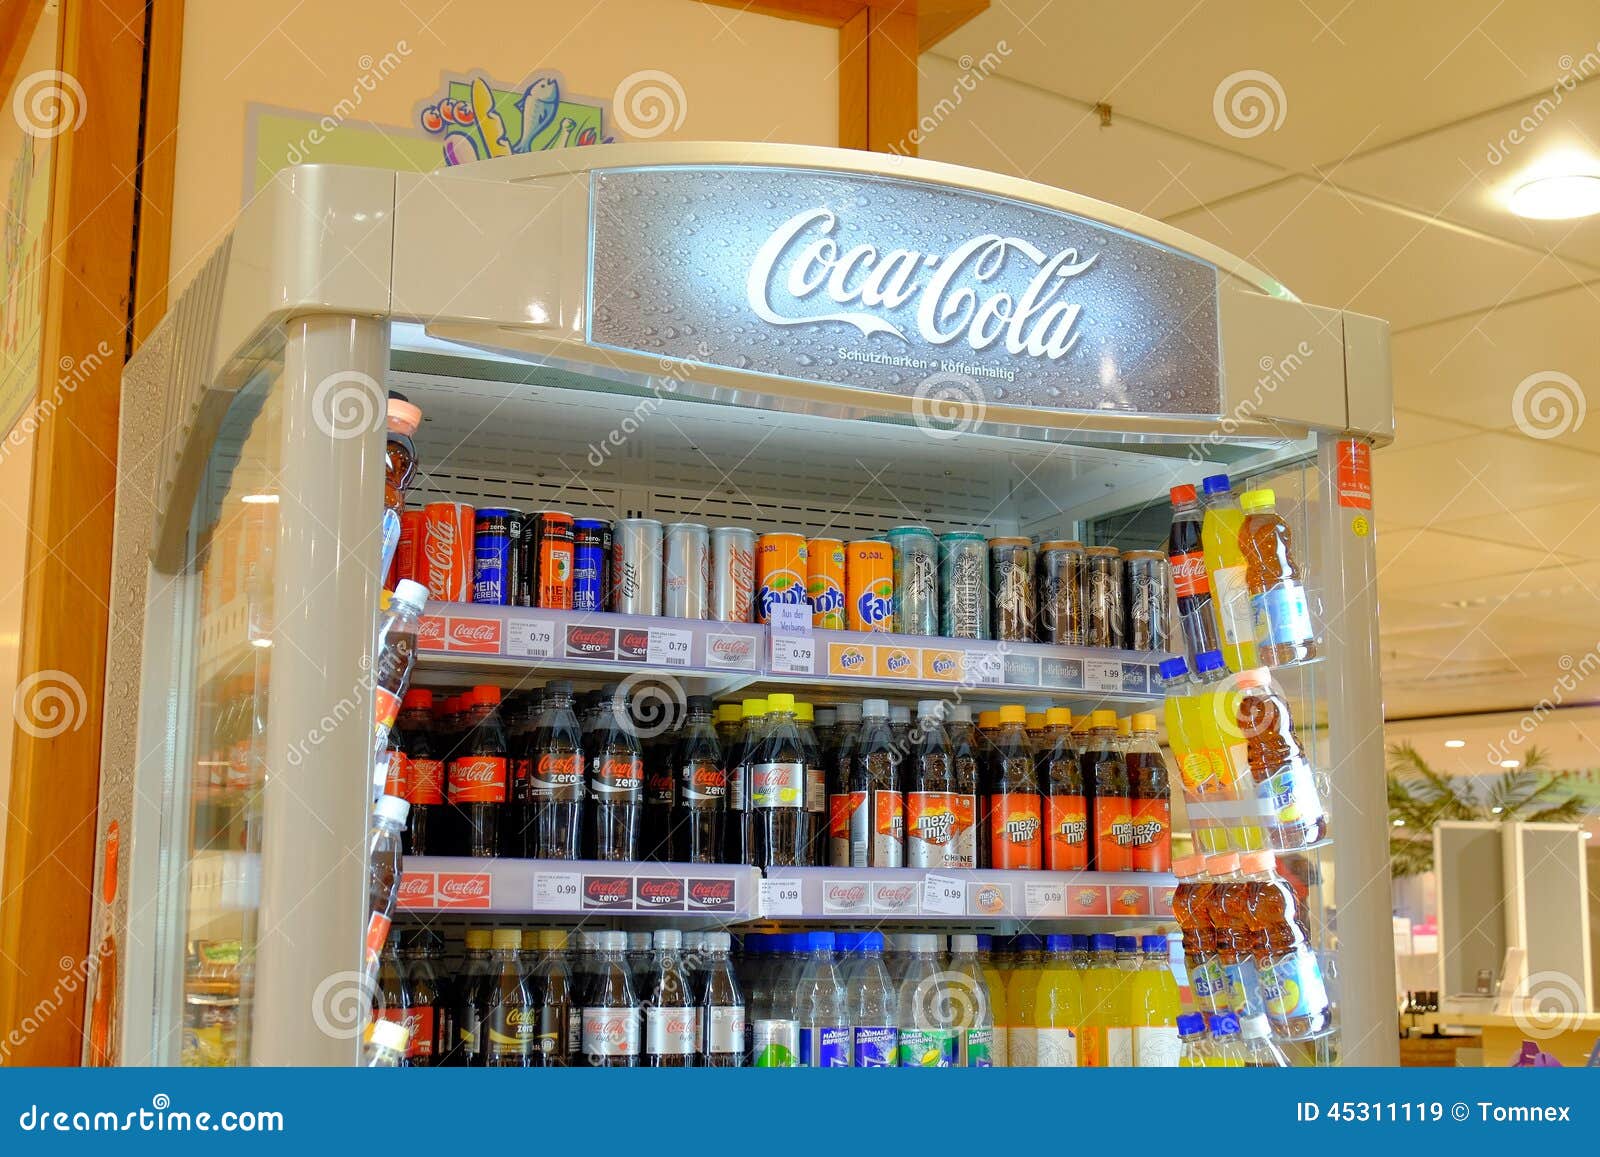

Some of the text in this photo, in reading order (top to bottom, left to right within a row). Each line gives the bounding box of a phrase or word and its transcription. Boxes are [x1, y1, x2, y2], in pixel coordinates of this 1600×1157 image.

[747, 206, 1101, 360] Coca-Cola
[838, 348, 928, 370] Schutzmarken
[858, 592, 894, 625] Fan
[530, 633, 550, 642] 0.79
[581, 643, 601, 652] zero
[632, 646, 648, 655] zer
[669, 641, 688, 651] 0.79
[793, 649, 811, 658] 0.79
[1103, 670, 1119, 678] 1.99
[551, 774, 578, 783] zero
[615, 777, 641, 788] zero
[918, 812, 956, 829] mezzo
[1006, 817, 1039, 834] mezzo
[923, 823, 949, 839] mix
[1012, 830, 1035, 843] mix
[557, 884, 577, 894] 0.99
[944, 889, 961, 899] 0.99
[599, 894, 618, 902] zero
[652, 896, 671, 904] zero
[702, 896, 722, 904] zero
[780, 890, 798, 900] 0.99
